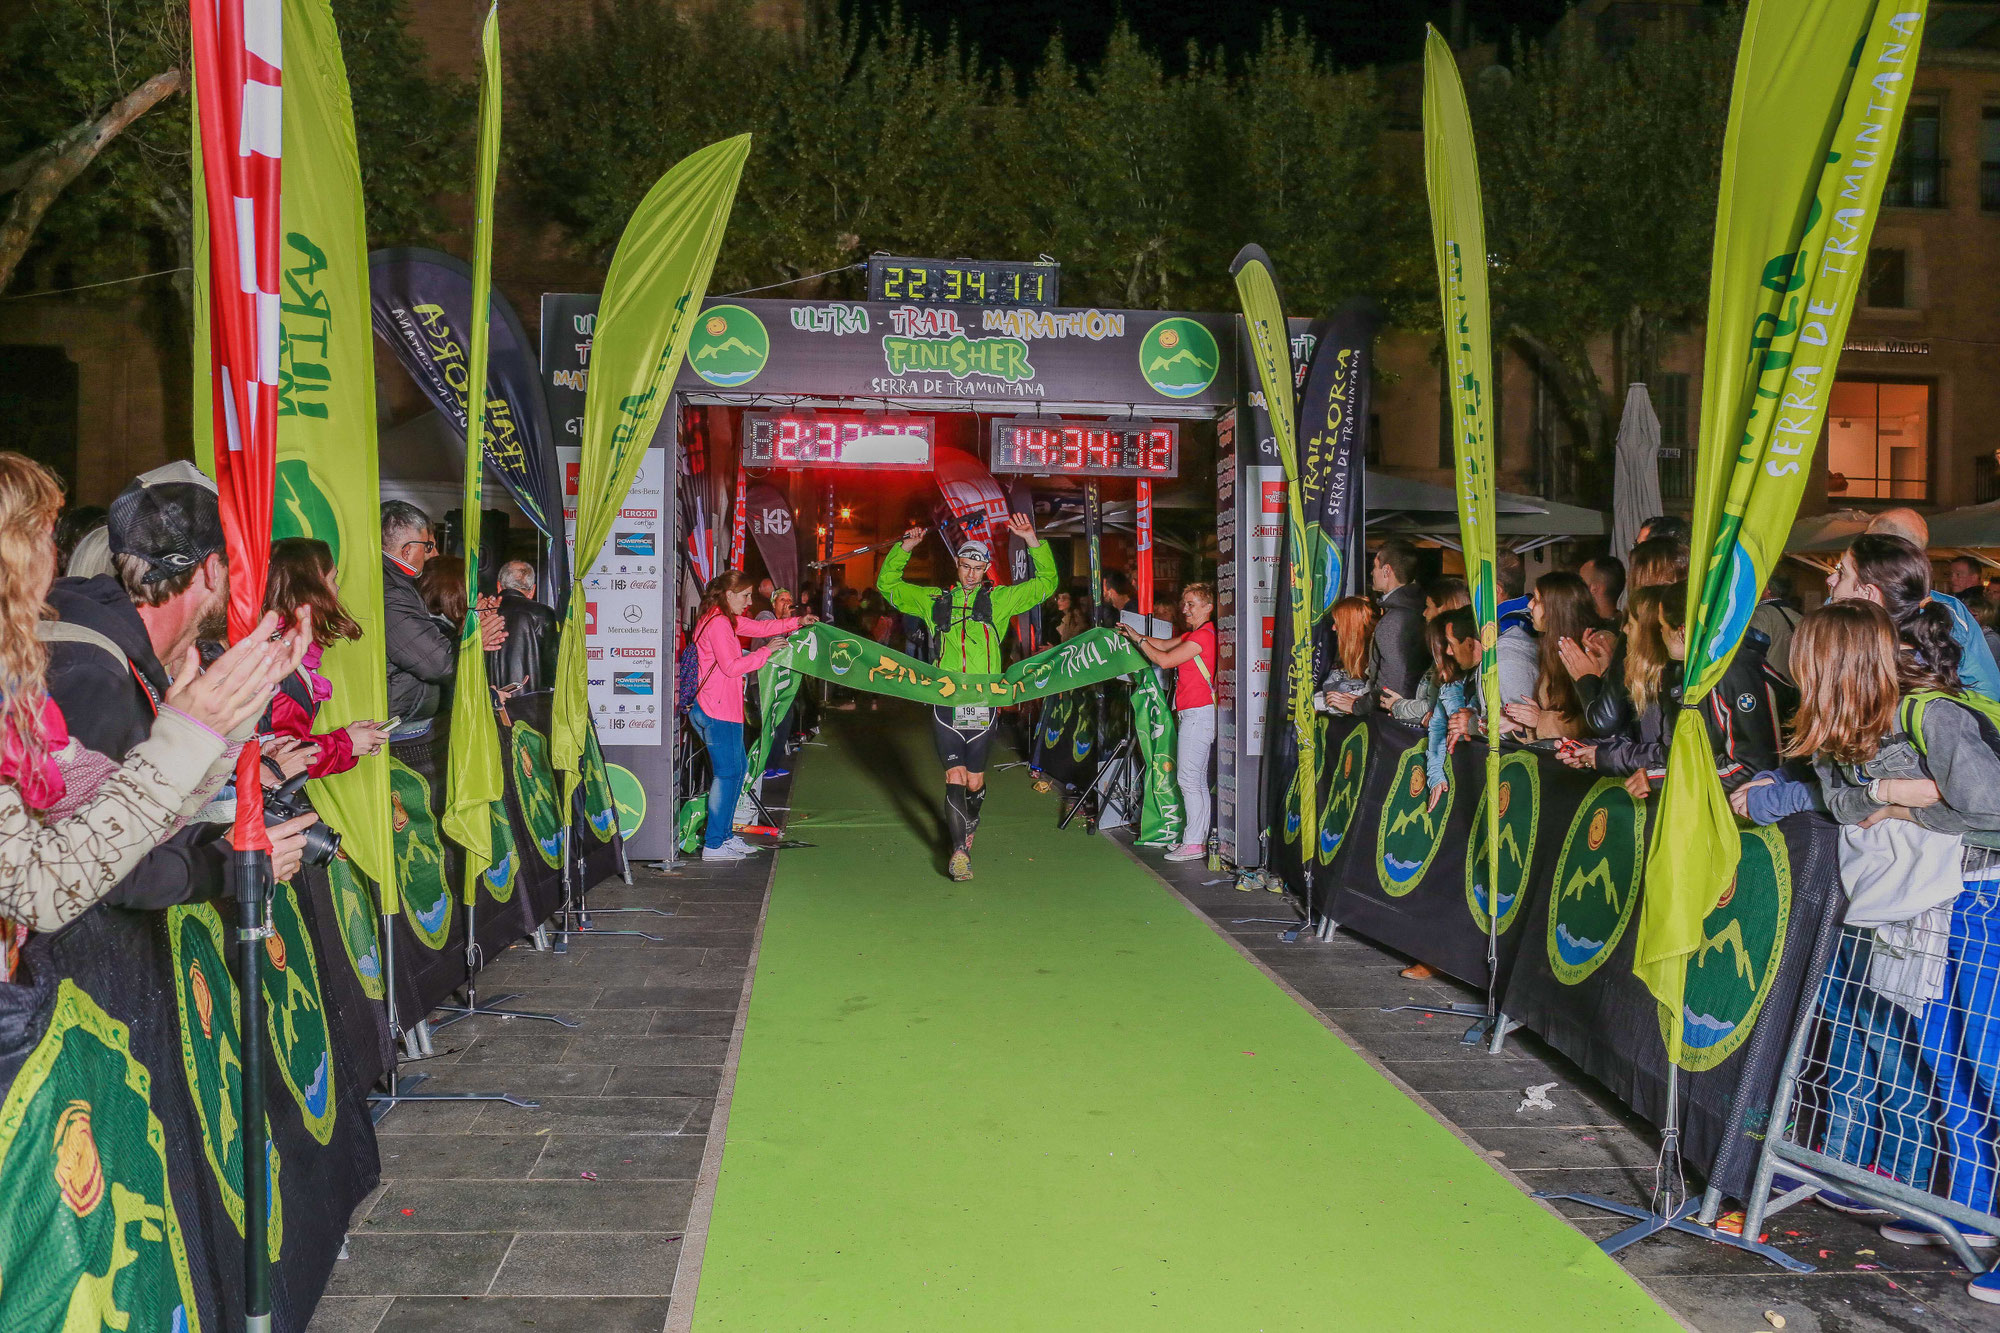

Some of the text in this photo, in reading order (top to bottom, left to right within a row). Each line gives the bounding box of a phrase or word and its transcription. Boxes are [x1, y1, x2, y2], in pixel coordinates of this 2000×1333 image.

[1765, 366, 1822, 477] SERRA
[1798, 298, 1838, 346] DE
[1822, 12, 1922, 277] TRAMUNTANA
[884, 267, 927, 299] 22
[943, 269, 985, 300] 34
[791, 306, 869, 333] ULTRA
[891, 306, 964, 336] TRAIL
[982, 309, 1125, 340] MARATHON
[885, 337, 1032, 381] FINISHER
[871, 377, 1045, 397] SERRA DE TRAMUNTANA
[1014, 428, 1170, 470] 14:34:12
[1328, 350, 1361, 516] SERRA DE TRAMUNTANA
[1303, 431, 1322, 505] TRAIL
[607, 626, 659, 634] Mercedes-Benz
[1059, 641, 1108, 678] TRAIL
[962, 706, 976, 716] 199
